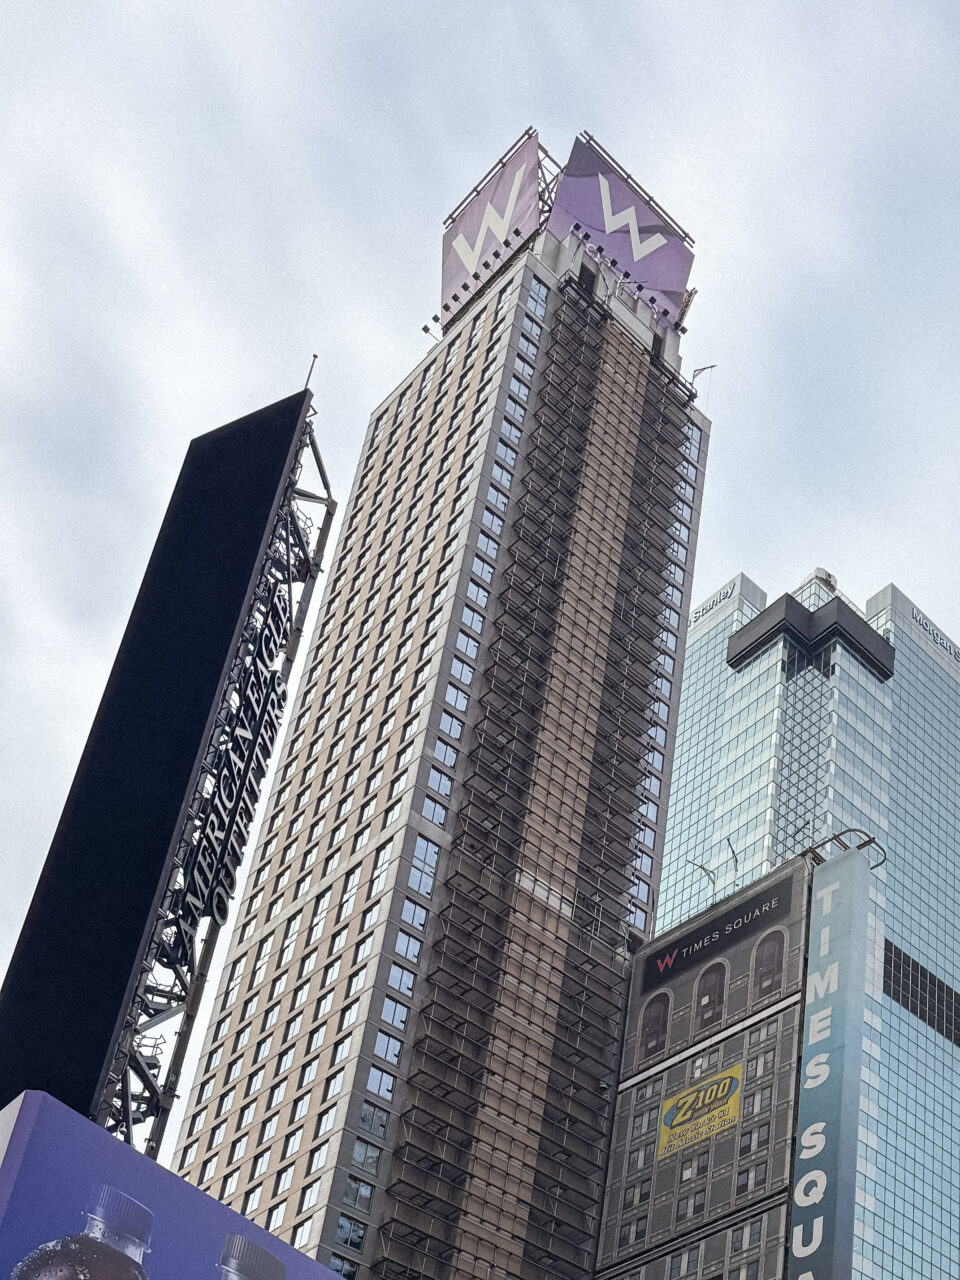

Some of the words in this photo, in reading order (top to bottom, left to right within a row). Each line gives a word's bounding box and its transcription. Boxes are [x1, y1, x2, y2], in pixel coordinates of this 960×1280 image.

[452, 163, 526, 273] W
[599, 172, 667, 262] W
[912, 607, 953, 655] Morgan
[681, 930, 720, 958] TIMES
[725, 898, 779, 935] SQUARE
[804, 881, 840, 1089] TIMES
[671, 1076, 733, 1129] Z100
[668, 1128, 690, 1144] New
